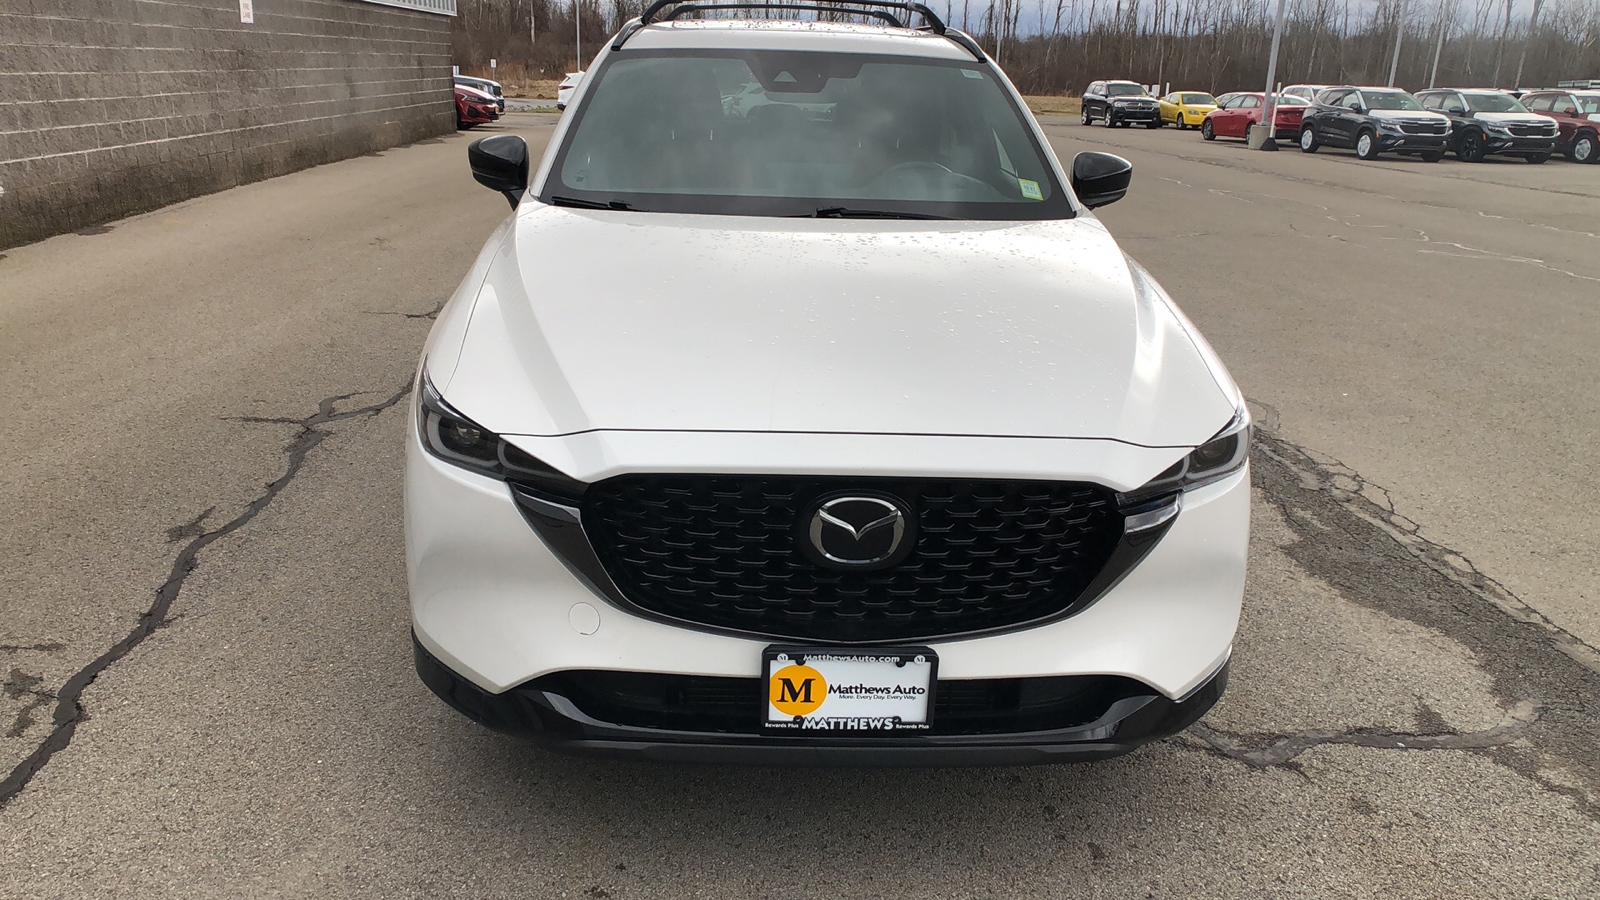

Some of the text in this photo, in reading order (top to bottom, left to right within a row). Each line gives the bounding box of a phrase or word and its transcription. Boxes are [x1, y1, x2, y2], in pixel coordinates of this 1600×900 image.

[803, 653, 900, 663] MatthewsAuto.com
[776, 677, 816, 703] M
[828, 683, 926, 695] Matthews Auto
[801, 717, 894, 730] MATTHEWS
